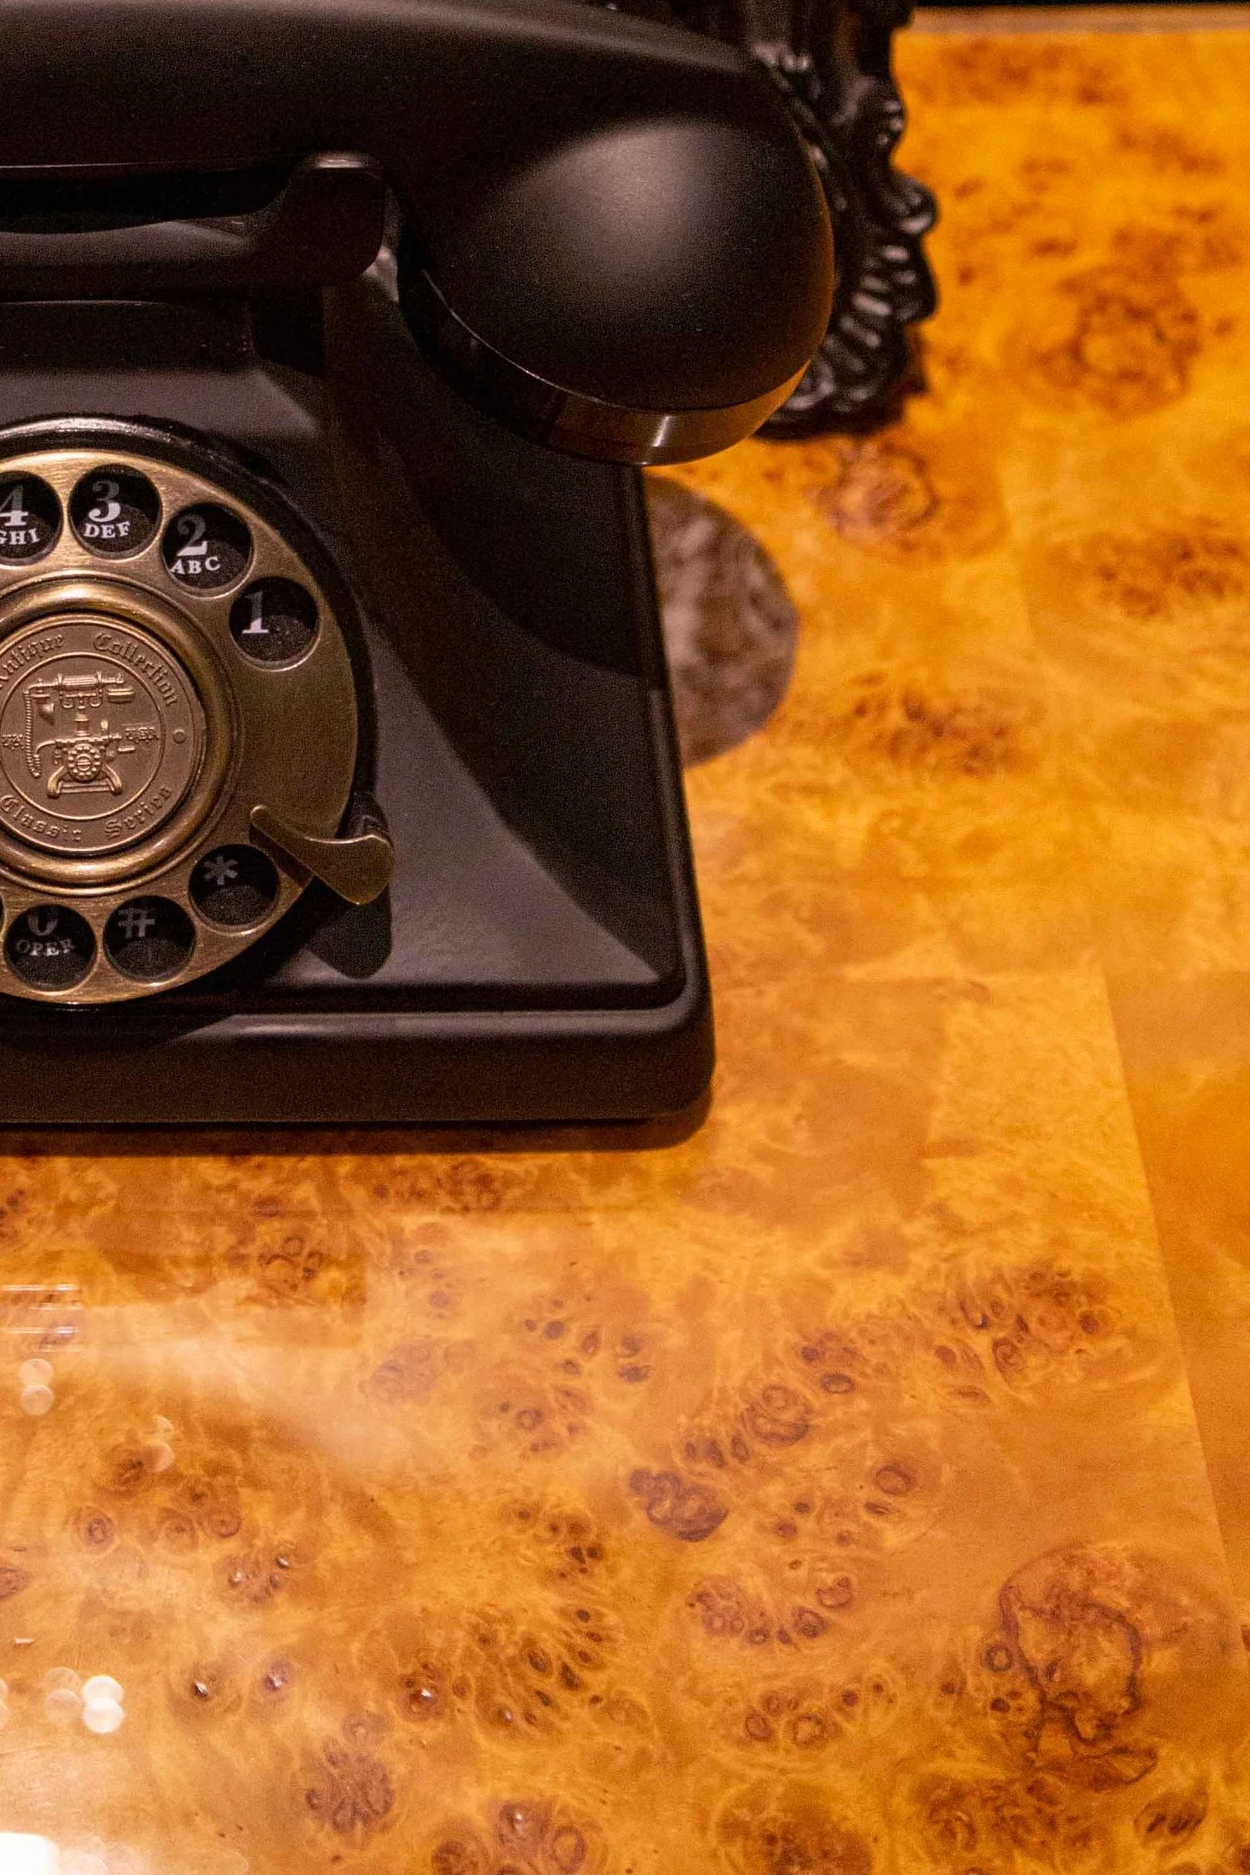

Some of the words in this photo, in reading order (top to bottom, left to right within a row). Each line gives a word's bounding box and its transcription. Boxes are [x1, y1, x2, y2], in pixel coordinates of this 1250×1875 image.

[88, 480, 122, 523] 3
[83, 520, 132, 539] DEF
[177, 513, 208, 557] 2
[170, 555, 221, 575] ABC
[242, 590, 269, 634] 1
[92, 631, 178, 707] Collection
[0, 793, 83, 843] Classic
[103, 786, 174, 840] Series
[14, 937, 75, 957] OPER
